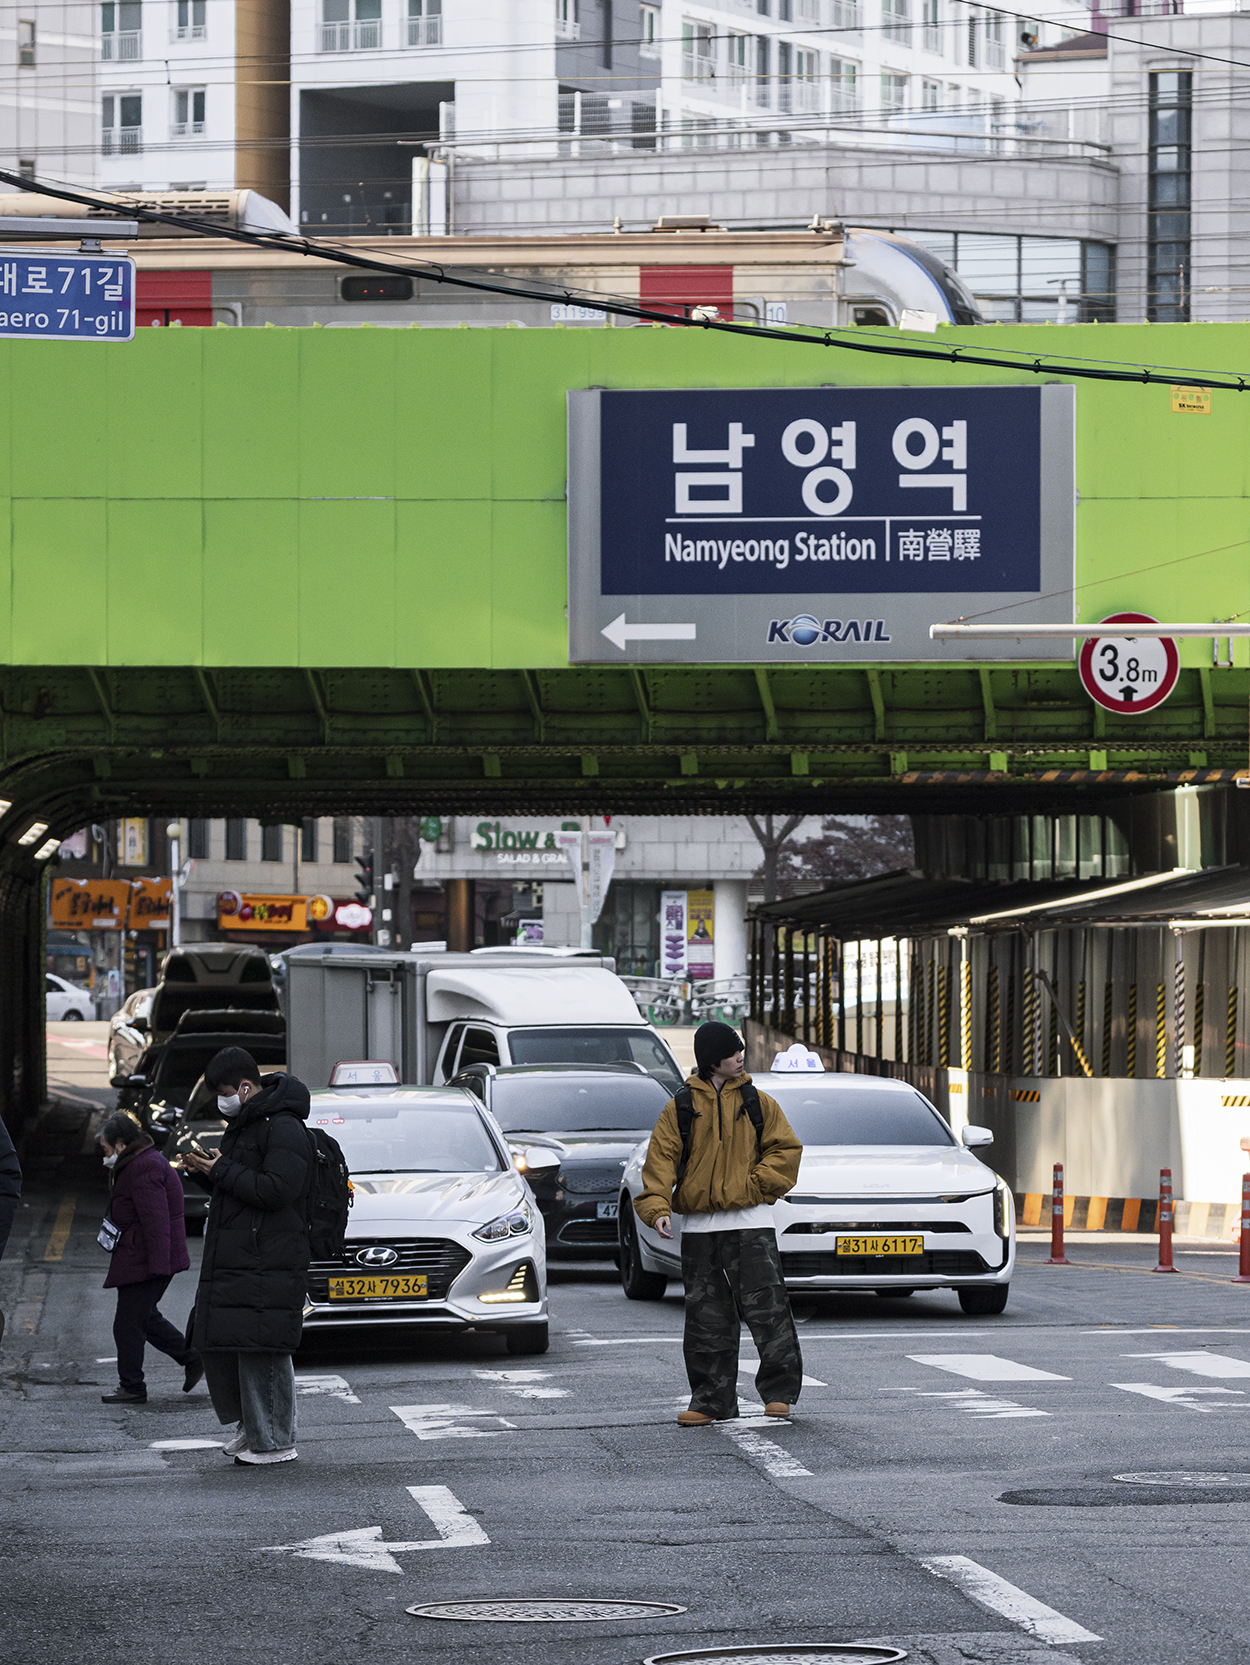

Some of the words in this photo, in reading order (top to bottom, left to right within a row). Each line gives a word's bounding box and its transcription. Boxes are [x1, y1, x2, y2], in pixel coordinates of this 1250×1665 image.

[57, 309, 123, 335] 71-gil
[768, 307, 785, 323] 10
[672, 417, 968, 517] 남영역
[665, 533, 790, 570] Namyeong
[795, 531, 876, 562] Station
[898, 528, 981, 561] 南營驛
[766, 614, 891, 646] KORAIL
[476, 821, 539, 850] Slow
[497, 853, 530, 864] SALAD
[532, 853, 540, 863] &
